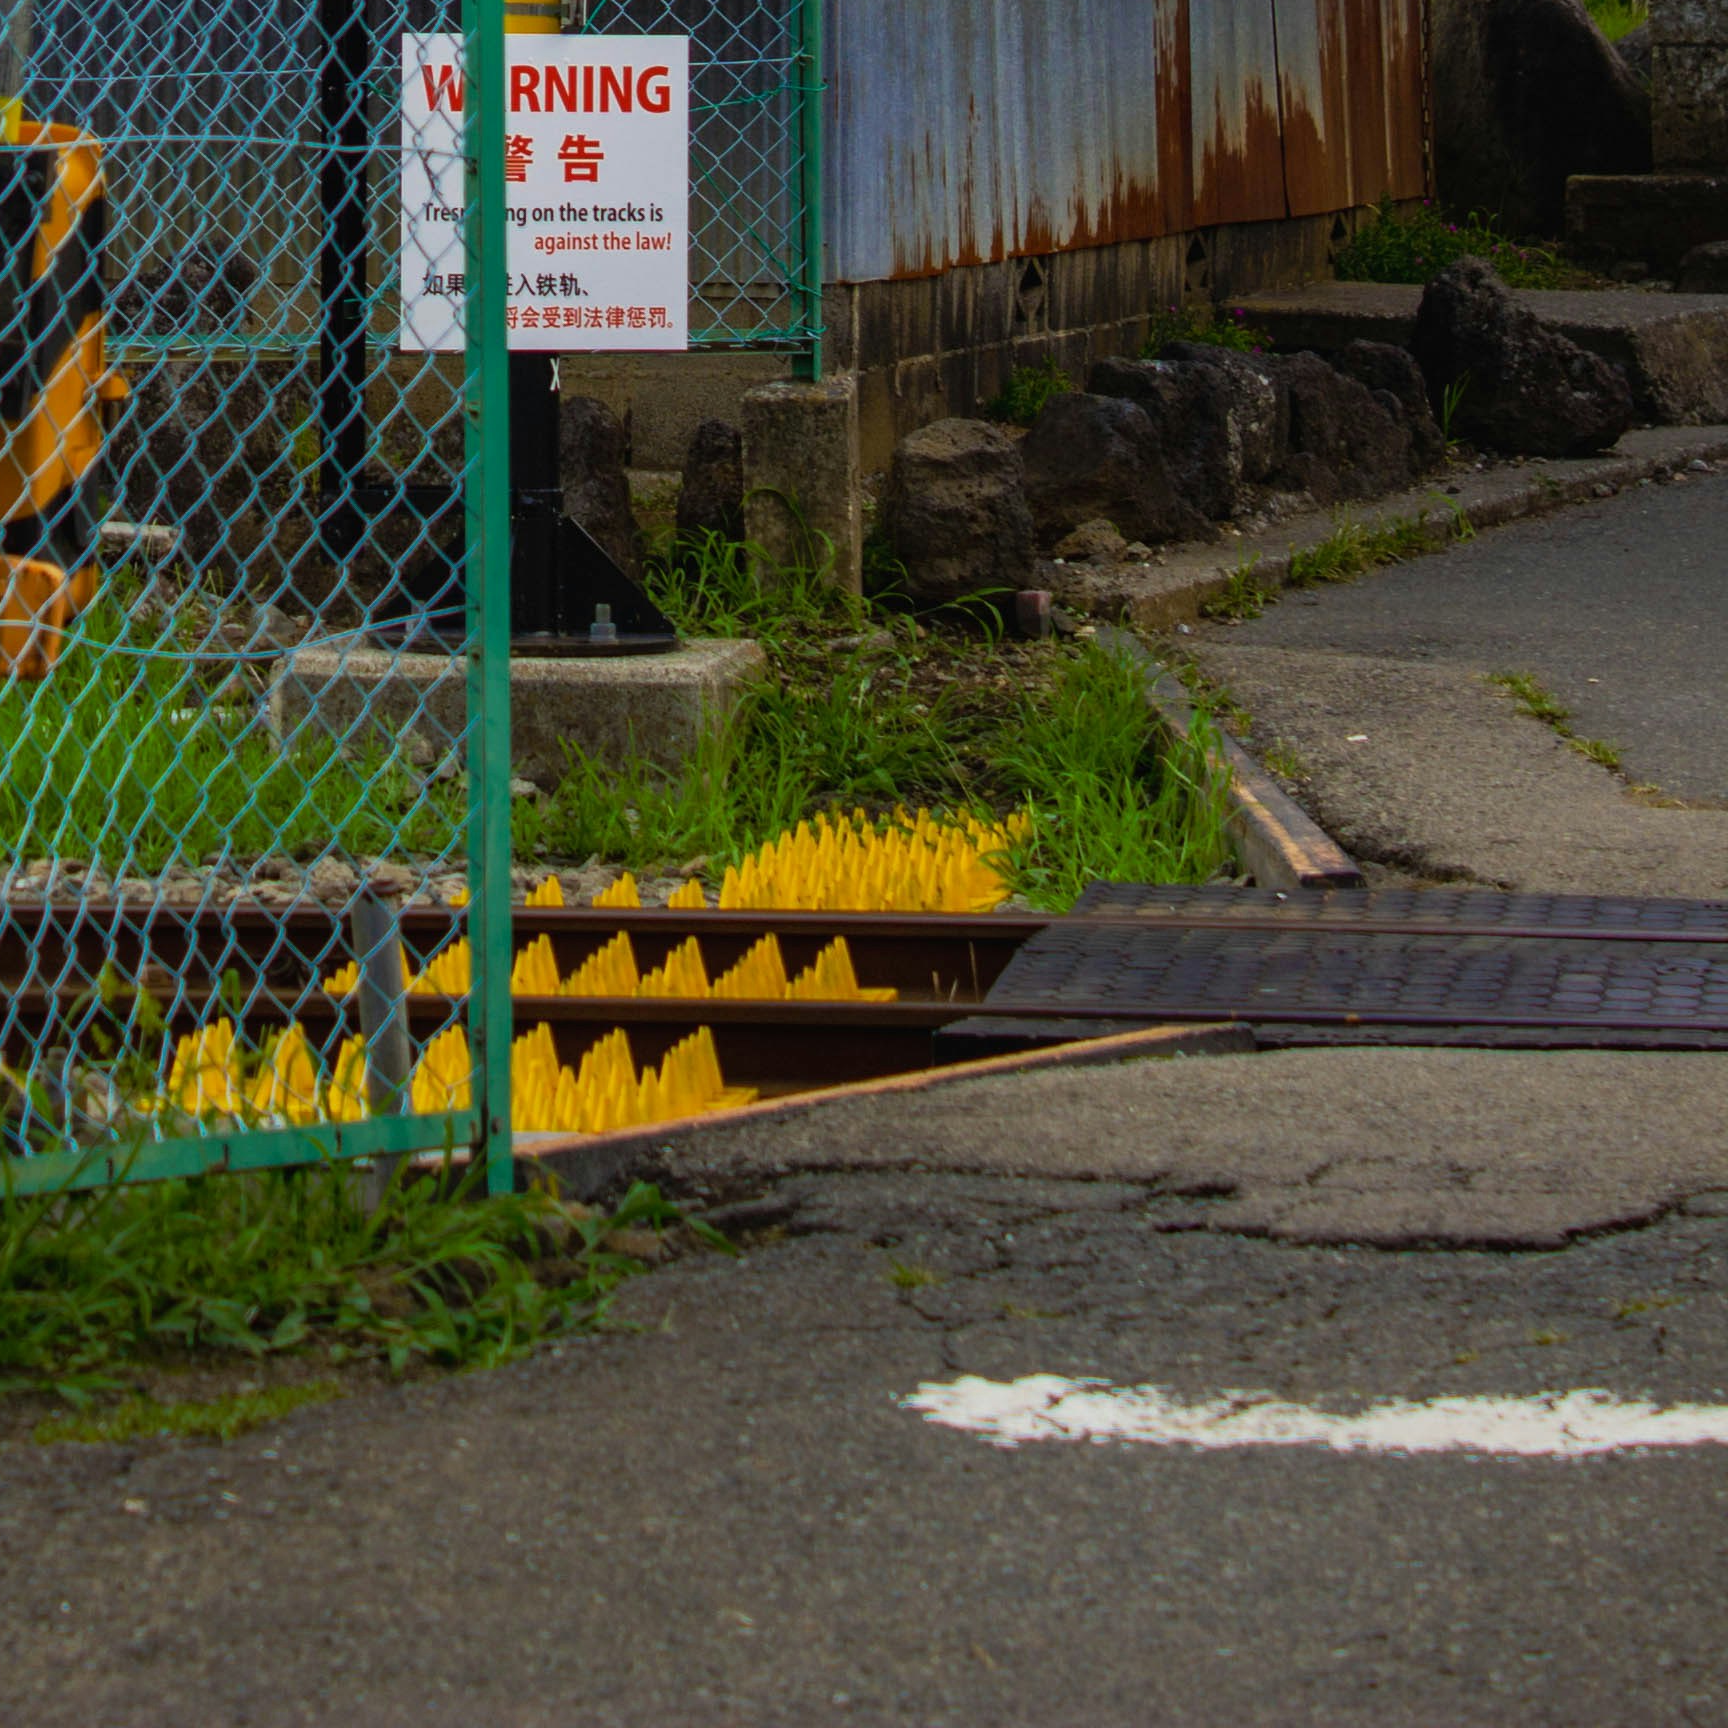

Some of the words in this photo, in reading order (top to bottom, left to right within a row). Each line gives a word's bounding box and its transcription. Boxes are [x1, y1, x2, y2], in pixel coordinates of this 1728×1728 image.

[422, 64, 671, 113] WRNING
[532, 208, 554, 222] on
[559, 203, 588, 222] the
[593, 203, 645, 222] tracks
[650, 203, 663, 222] is
[534, 232, 598, 255] against
[602, 231, 630, 250] the
[636, 231, 671, 250] law!
